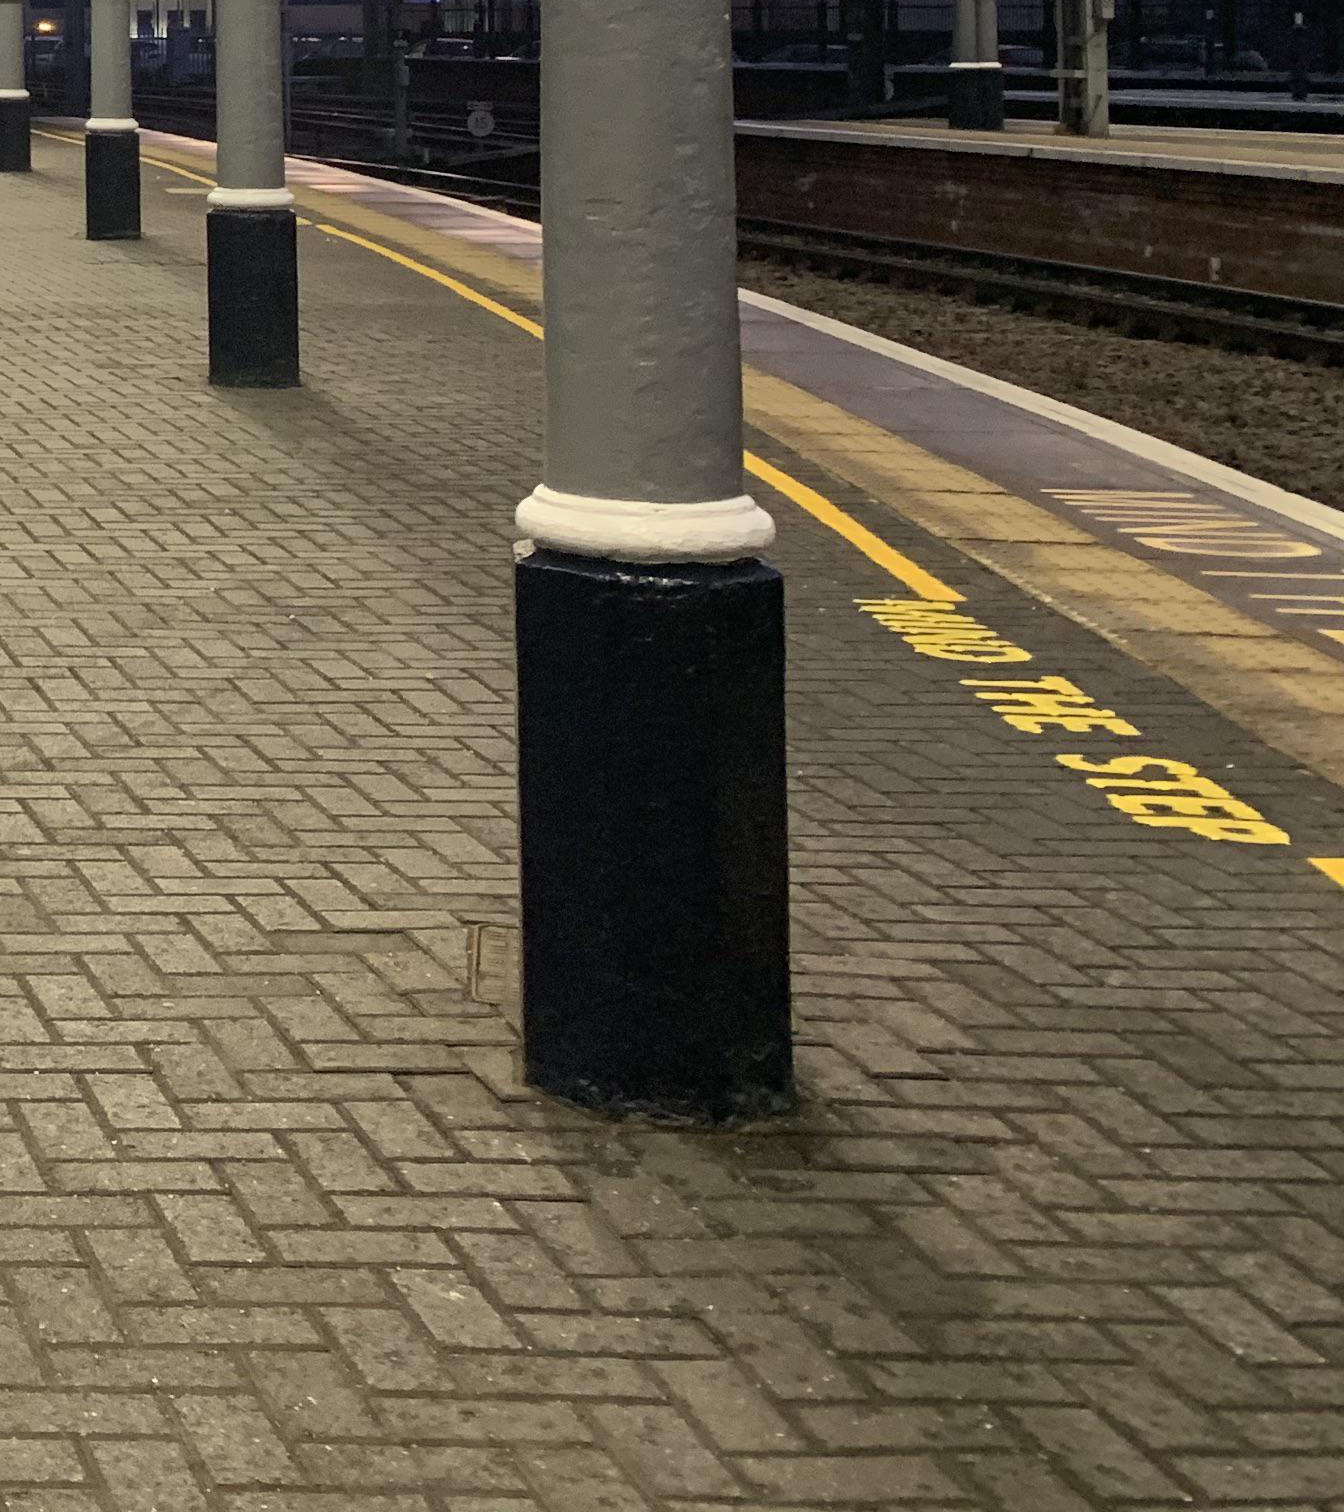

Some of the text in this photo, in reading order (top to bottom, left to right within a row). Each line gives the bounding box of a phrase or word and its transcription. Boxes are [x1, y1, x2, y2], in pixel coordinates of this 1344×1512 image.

[1040, 488, 1323, 558] MIND
[852, 598, 1291, 846] MIND THE STEP
